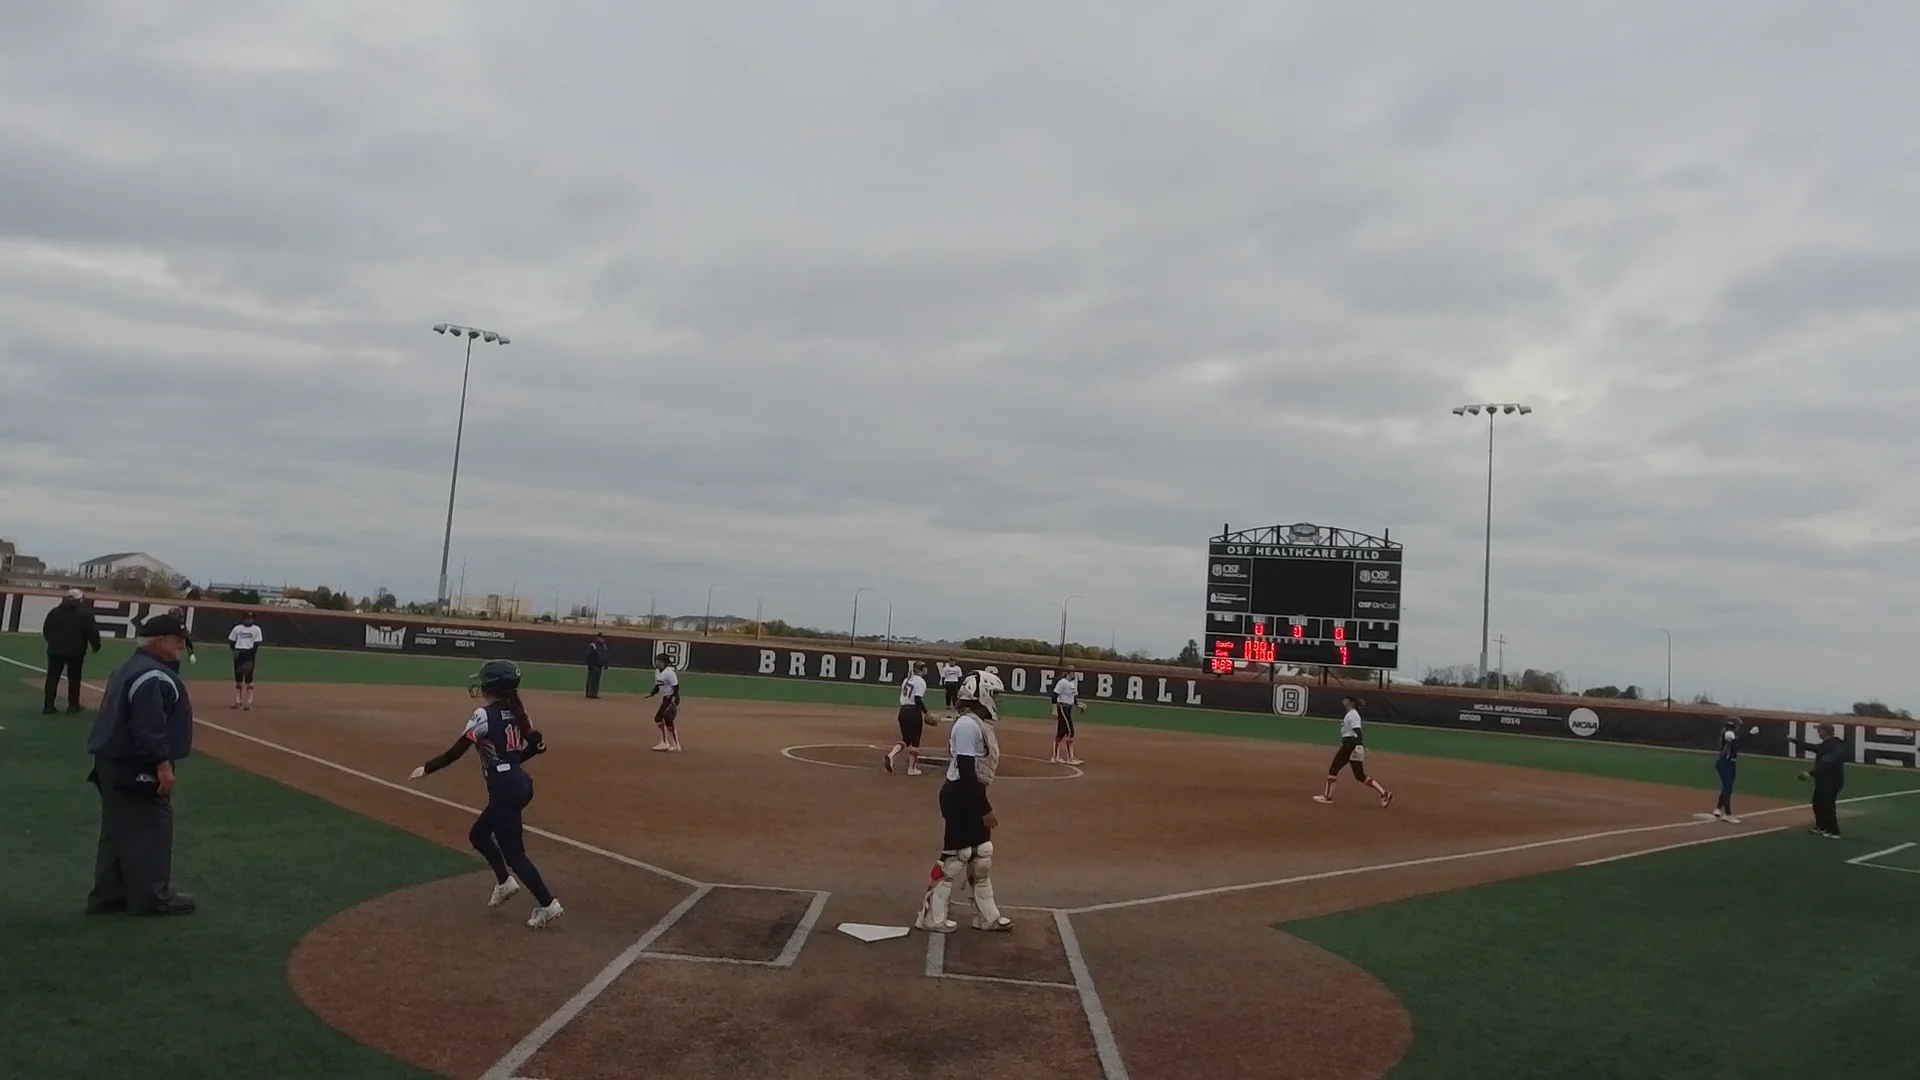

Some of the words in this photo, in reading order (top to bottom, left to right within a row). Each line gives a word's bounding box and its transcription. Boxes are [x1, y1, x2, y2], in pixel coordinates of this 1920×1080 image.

[1227, 546, 1250, 555] OSF
[1256, 547, 1337, 558] HEALTHCARE
[1342, 549, 1380, 560] FIELD
[1571, 720, 1598, 730] NCAA
